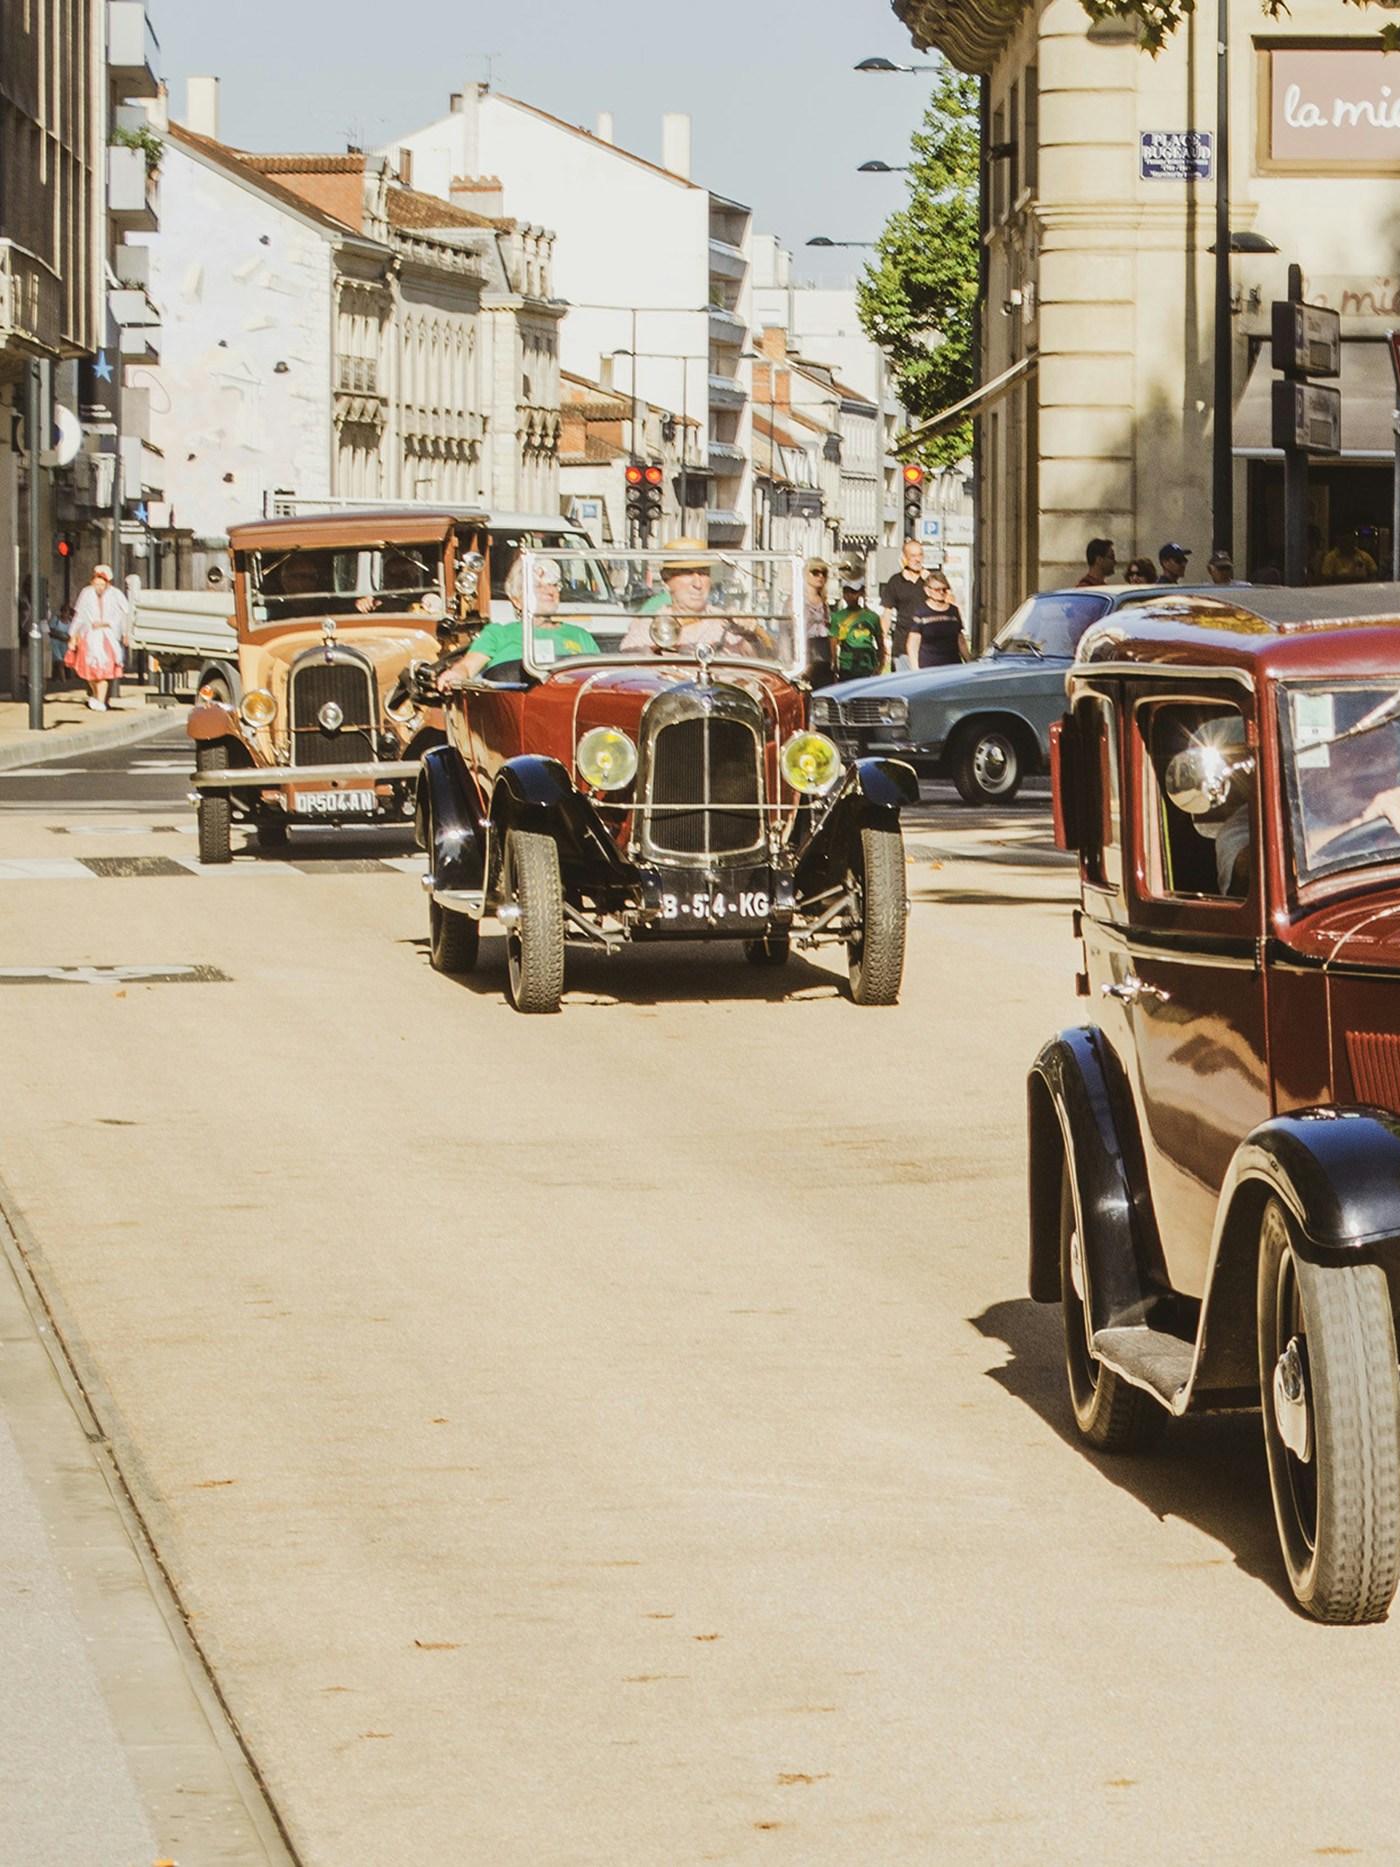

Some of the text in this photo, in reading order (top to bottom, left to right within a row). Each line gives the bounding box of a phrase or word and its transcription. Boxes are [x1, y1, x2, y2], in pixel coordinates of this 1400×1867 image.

[1283, 83, 1328, 128] la
[1151, 133, 1202, 147] PLACE
[1142, 145, 1212, 159] BUGEAUD
